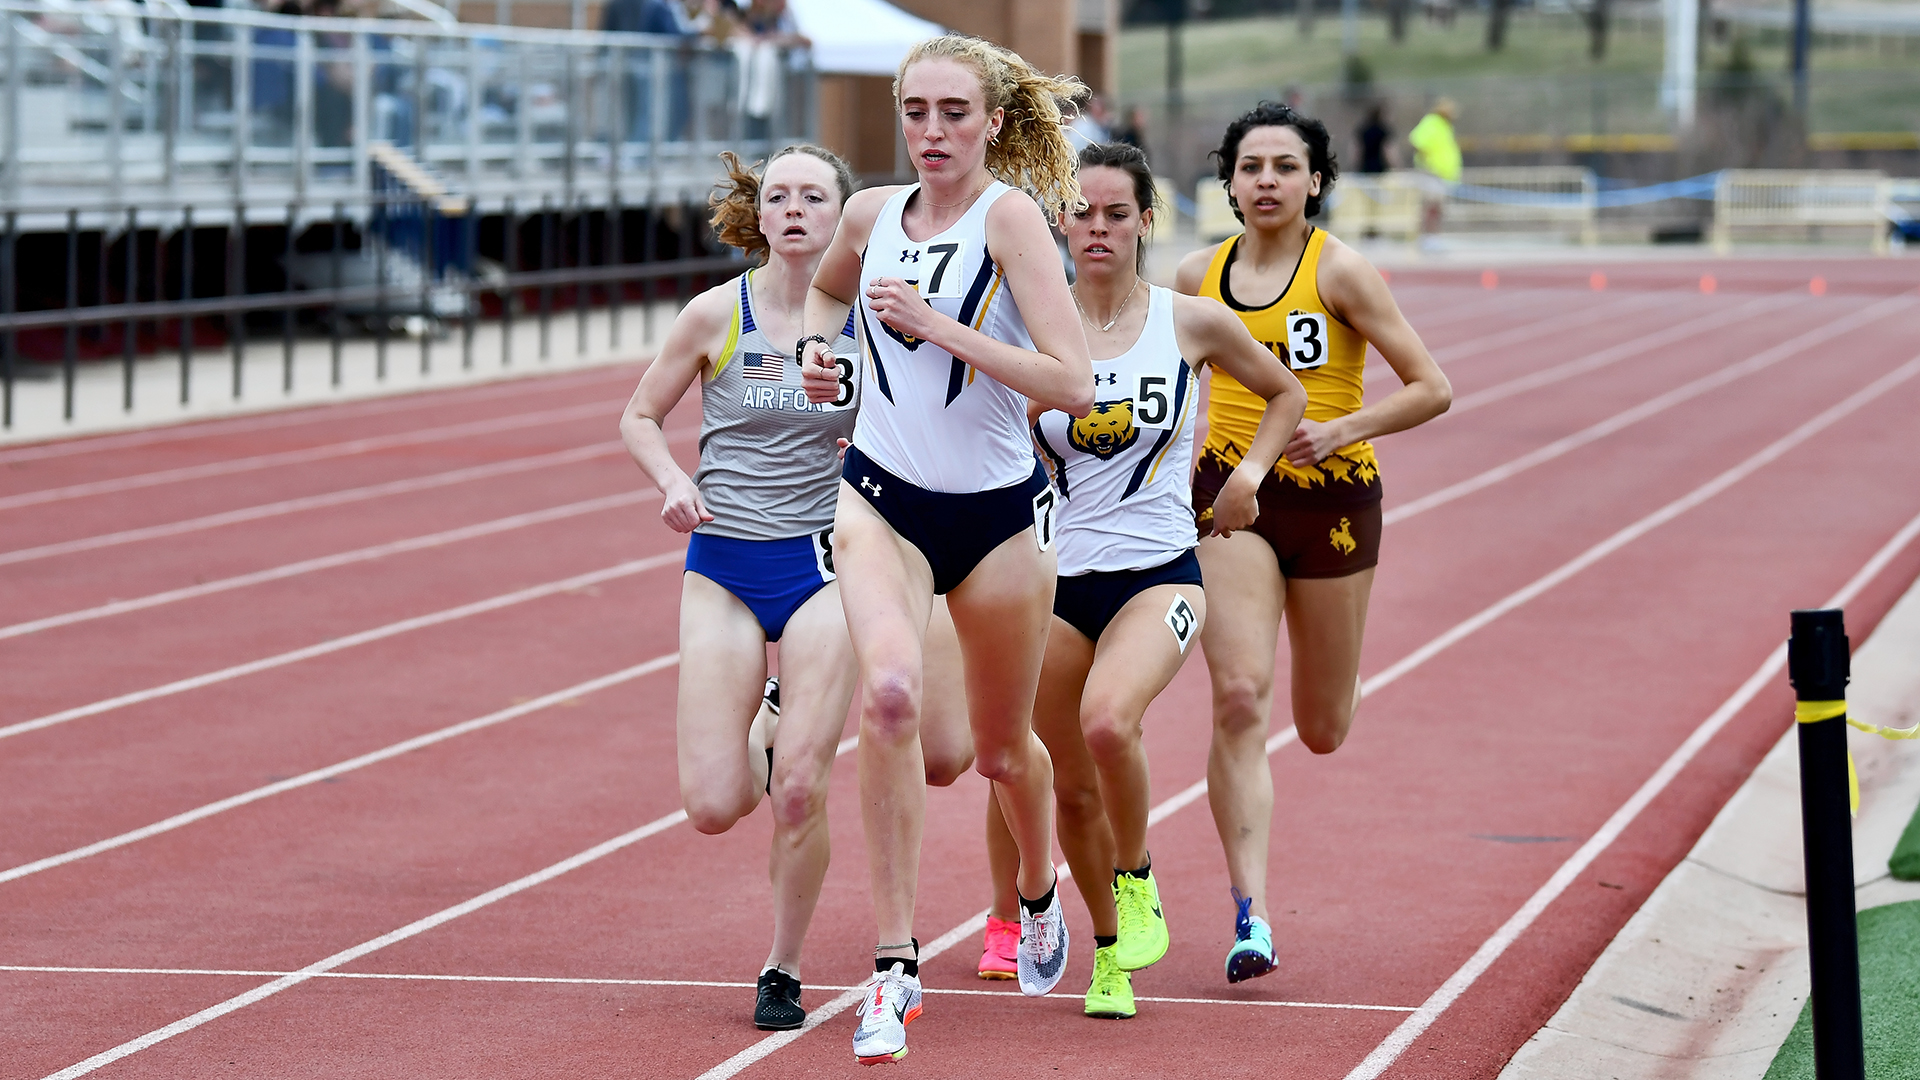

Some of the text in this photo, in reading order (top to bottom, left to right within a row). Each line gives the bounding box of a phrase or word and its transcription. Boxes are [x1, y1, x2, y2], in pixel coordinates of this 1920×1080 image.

[927, 243, 959, 294] 7
[1293, 317, 1322, 364] 3
[741, 385, 775, 410] AIR
[1137, 376, 1168, 424] 5
[1036, 489, 1054, 545] 7
[1171, 599, 1194, 642] 5
